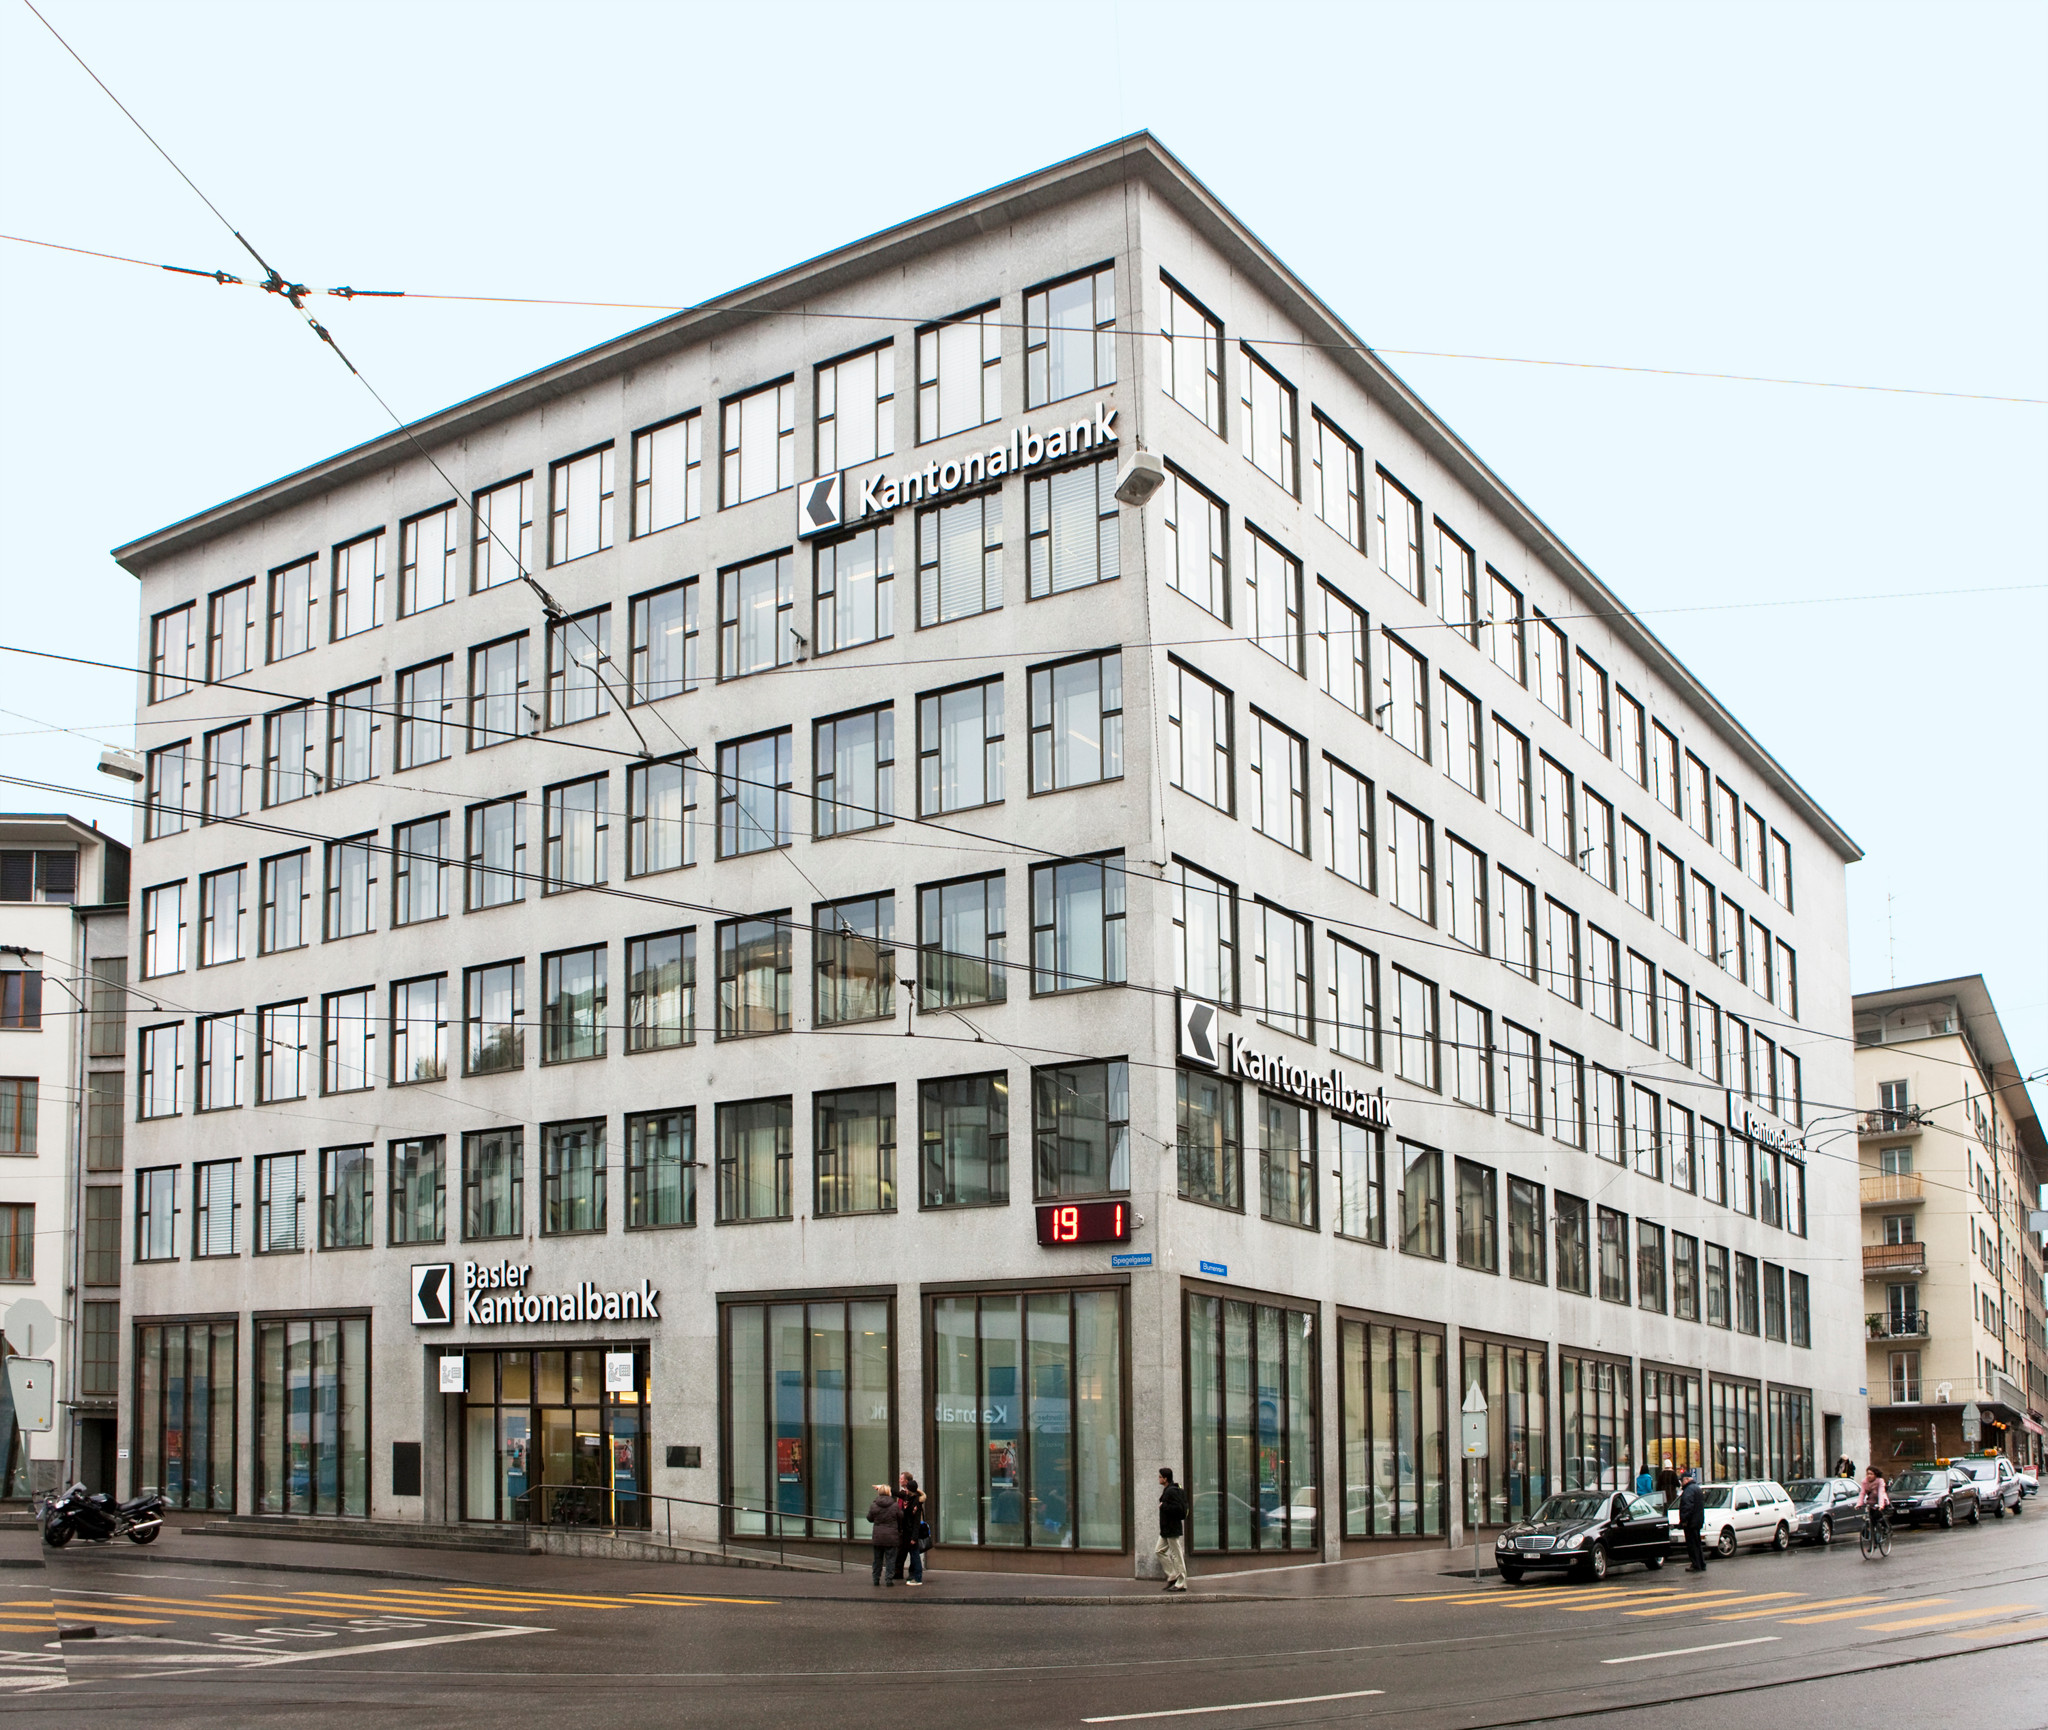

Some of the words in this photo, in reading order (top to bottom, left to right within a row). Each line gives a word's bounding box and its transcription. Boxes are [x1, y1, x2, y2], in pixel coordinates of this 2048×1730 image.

[859, 401, 1119, 517] Kantonalbank
[1229, 1032, 1394, 1127] Kantonalbank
[1053, 1206, 1078, 1241] 19
[1114, 1203, 1122, 1237] 1
[463, 1259, 532, 1290] Basler
[1112, 1255, 1150, 1265] Spiegelgasse
[463, 1278, 660, 1325] Kantonalbank
[209, 1618, 428, 1645] STOP
